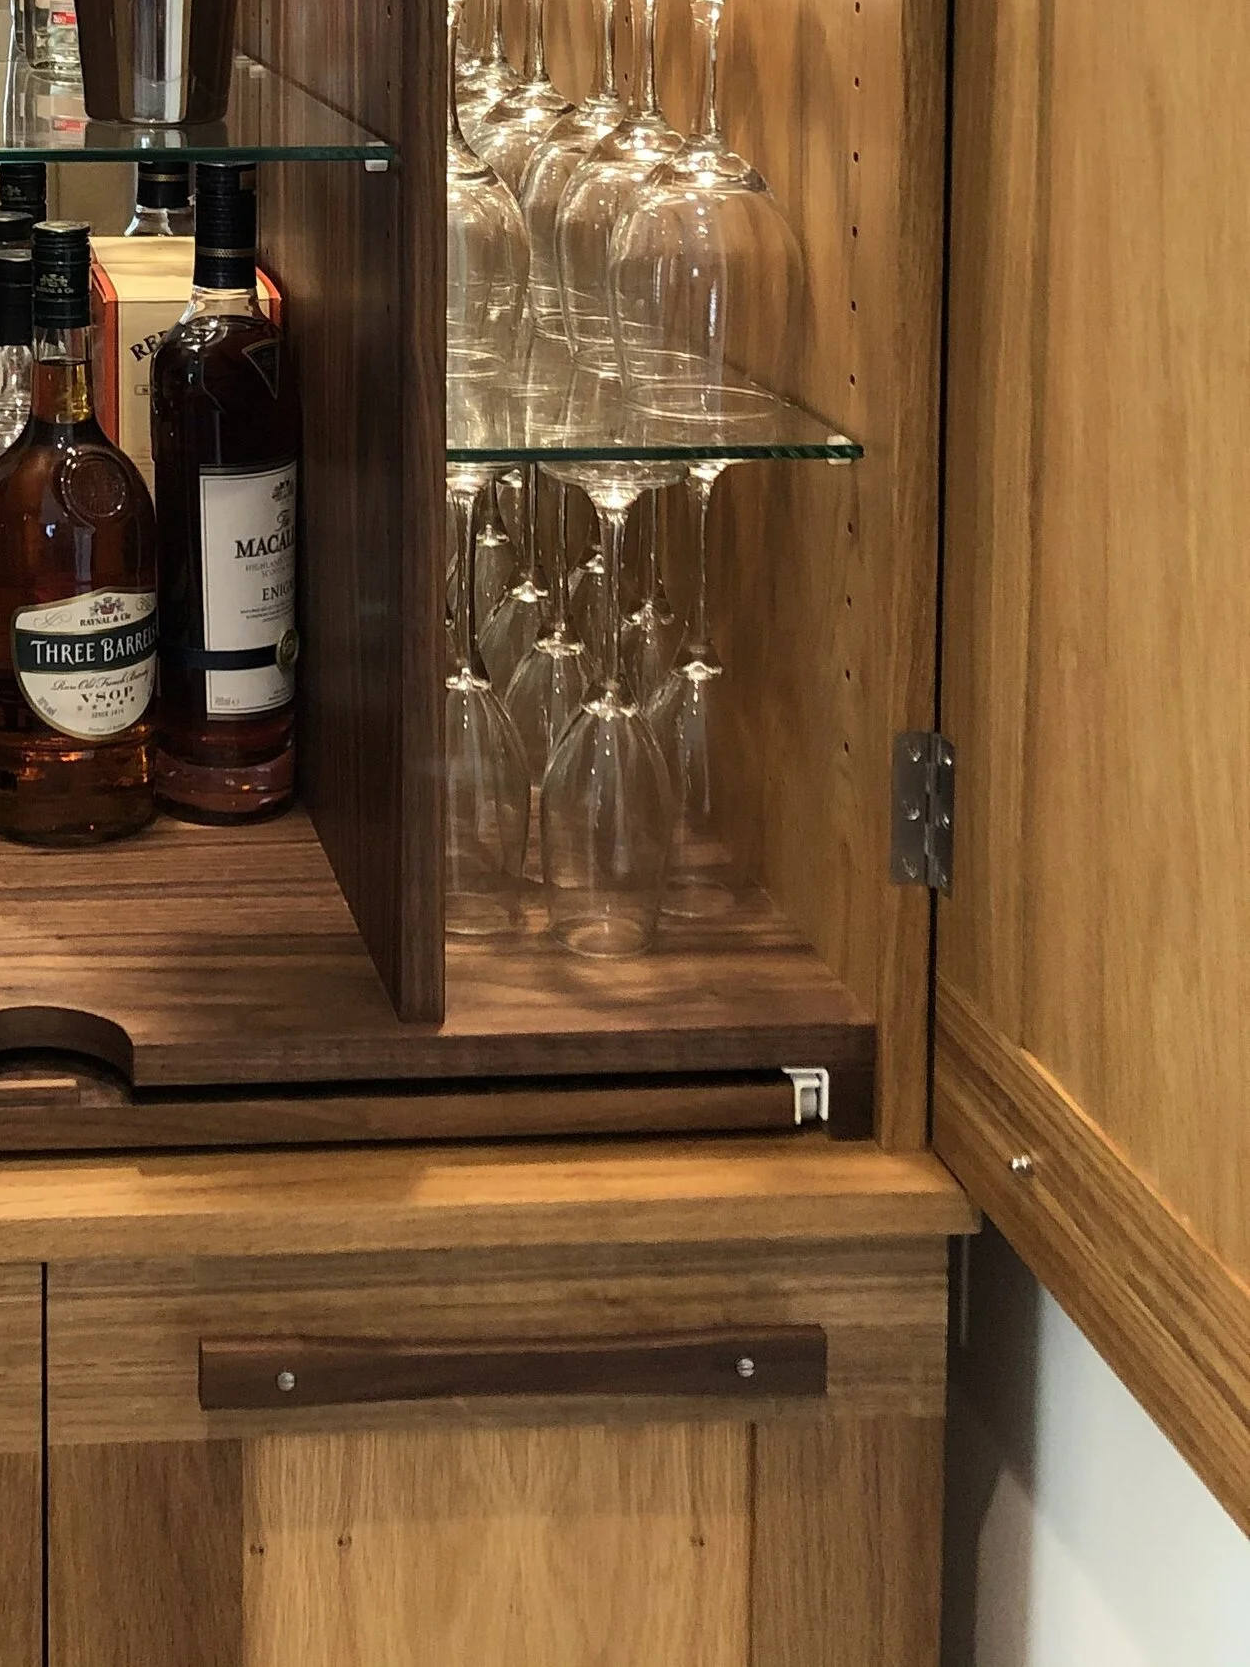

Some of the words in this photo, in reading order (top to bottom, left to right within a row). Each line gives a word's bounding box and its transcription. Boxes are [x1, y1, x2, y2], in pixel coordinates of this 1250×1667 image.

[79, 616, 111, 627] RAYNAL
[30, 639, 96, 665] THREE
[80, 685, 134, 703] VSOP
